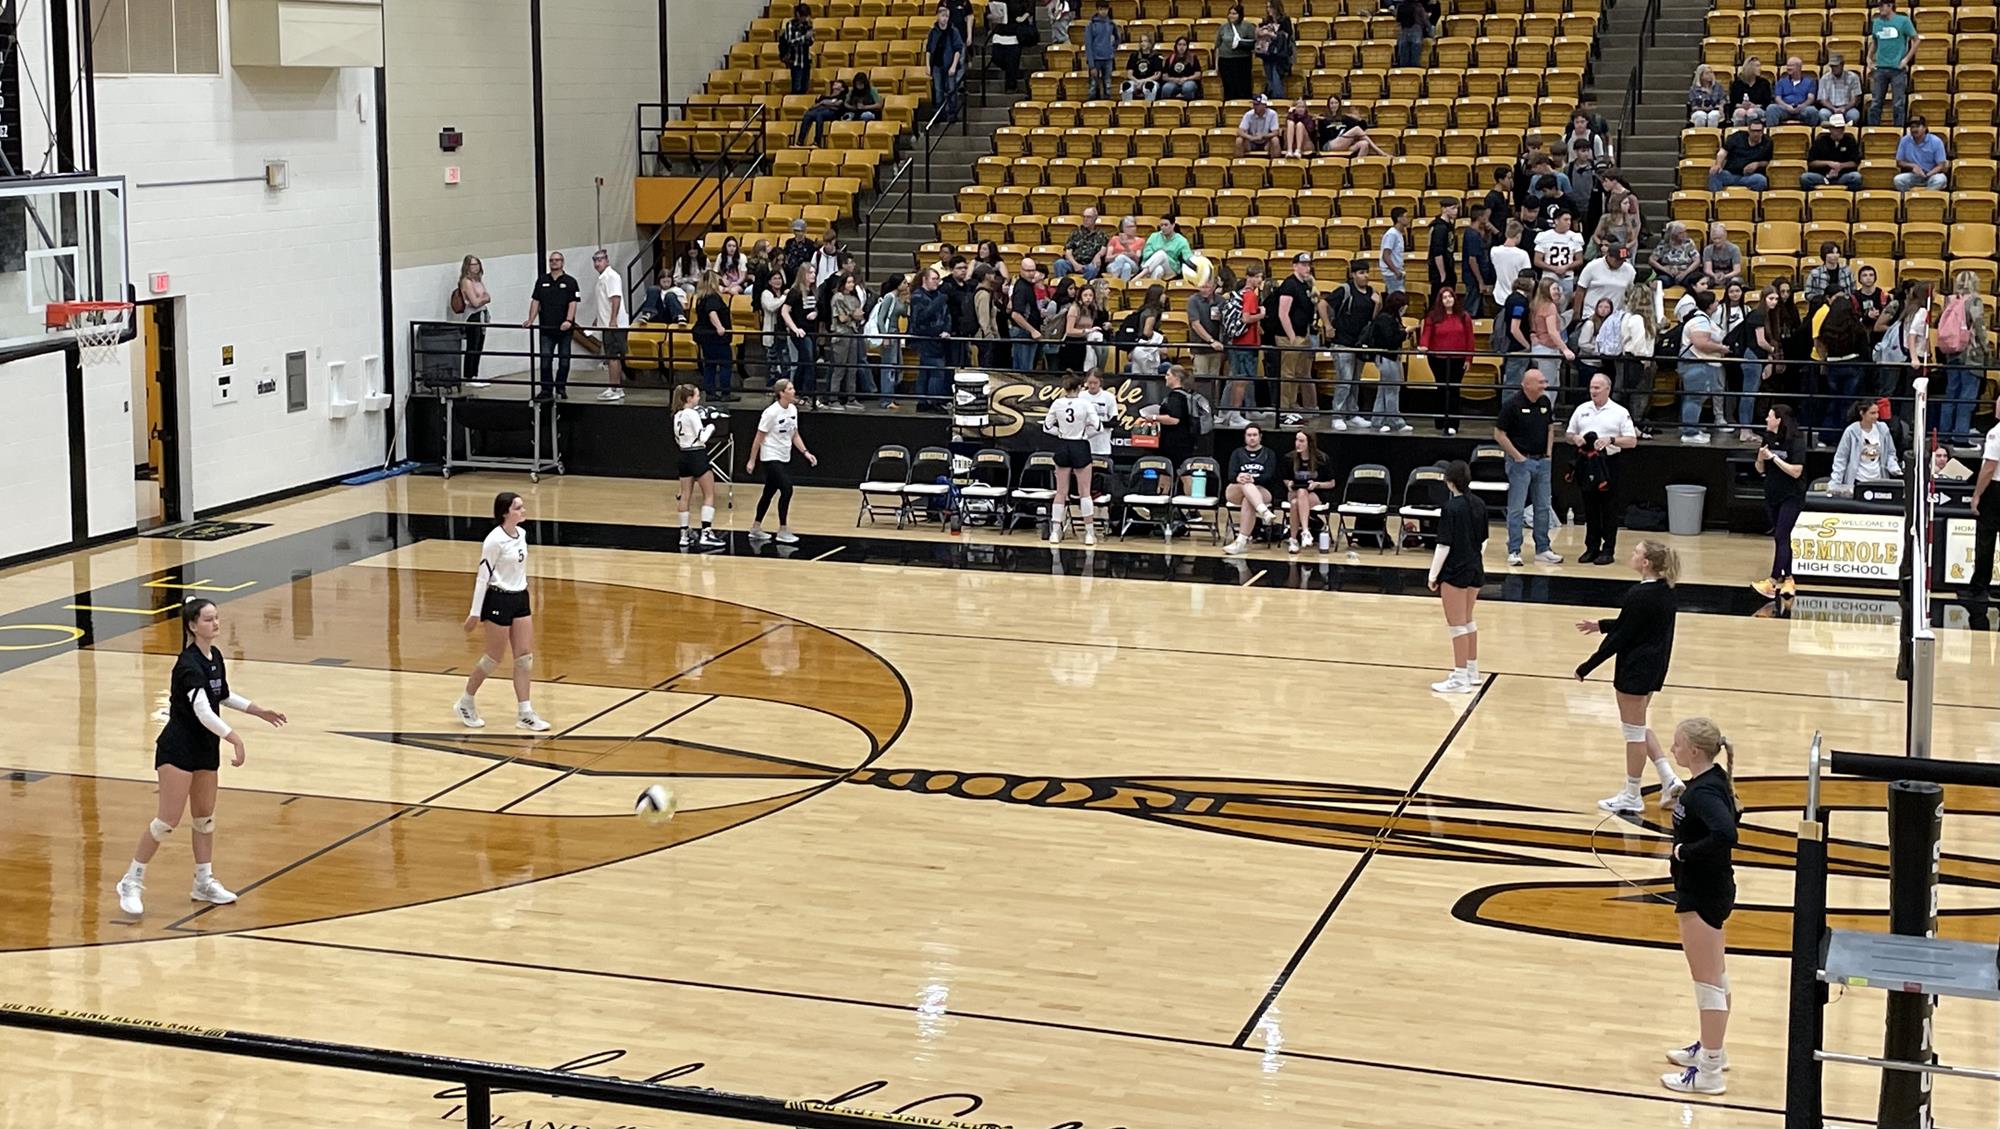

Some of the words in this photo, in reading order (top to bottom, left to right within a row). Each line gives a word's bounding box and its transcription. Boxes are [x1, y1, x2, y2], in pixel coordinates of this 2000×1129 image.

[1549, 246, 1571, 266] 23
[1065, 407, 1075, 425] 3
[677, 420, 685, 437] 2
[1841, 519, 1885, 528] WELCOME
[1887, 520, 1899, 529] TO
[518, 548, 525, 563] 5
[1791, 538, 1898, 565] SEMINOLE
[1797, 562, 1829, 573] HIGH
[1833, 563, 1889, 576] SCHOOL
